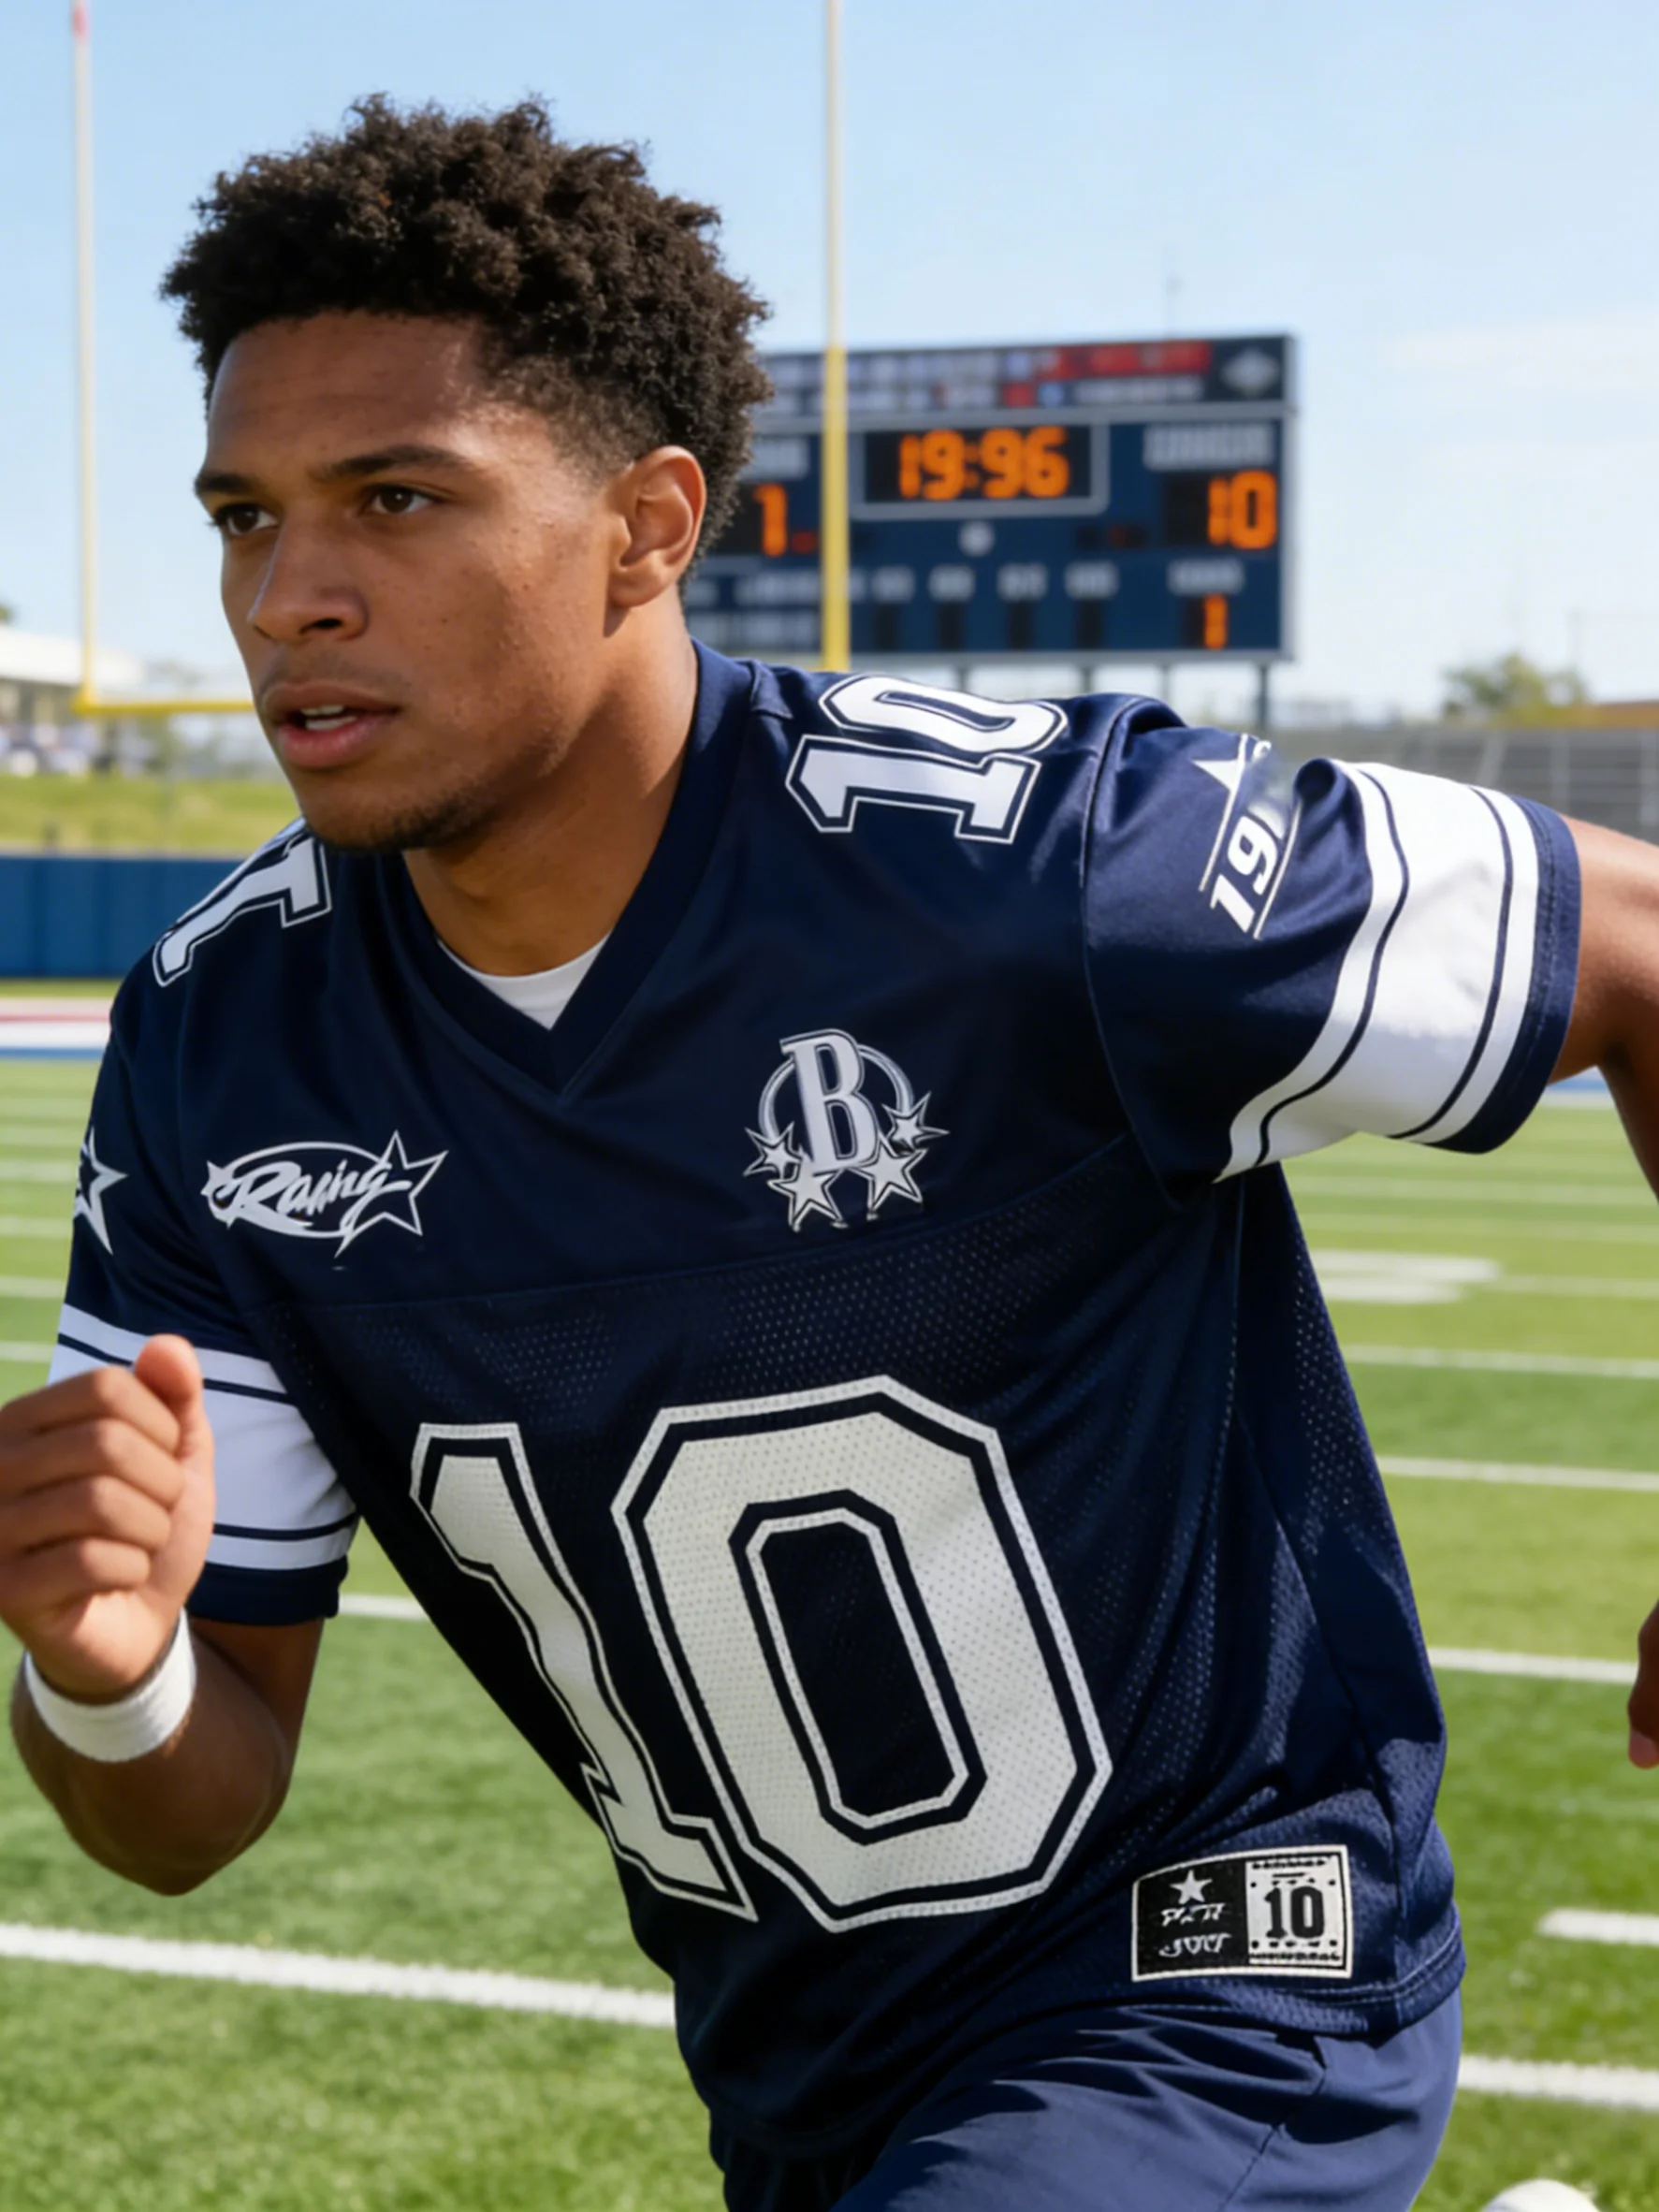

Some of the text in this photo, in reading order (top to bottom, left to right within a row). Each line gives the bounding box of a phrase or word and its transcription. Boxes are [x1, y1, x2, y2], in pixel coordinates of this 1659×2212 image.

[899, 425, 1071, 501] 19:96
[1207, 470, 1279, 549] 10
[754, 482, 789, 557] 1
[785, 673, 1070, 845] 10
[1210, 801, 1288, 934] 19
[779, 1027, 880, 1172] B
[409, 1374, 1113, 1934] 10
[1264, 1885, 1326, 1940] 10
